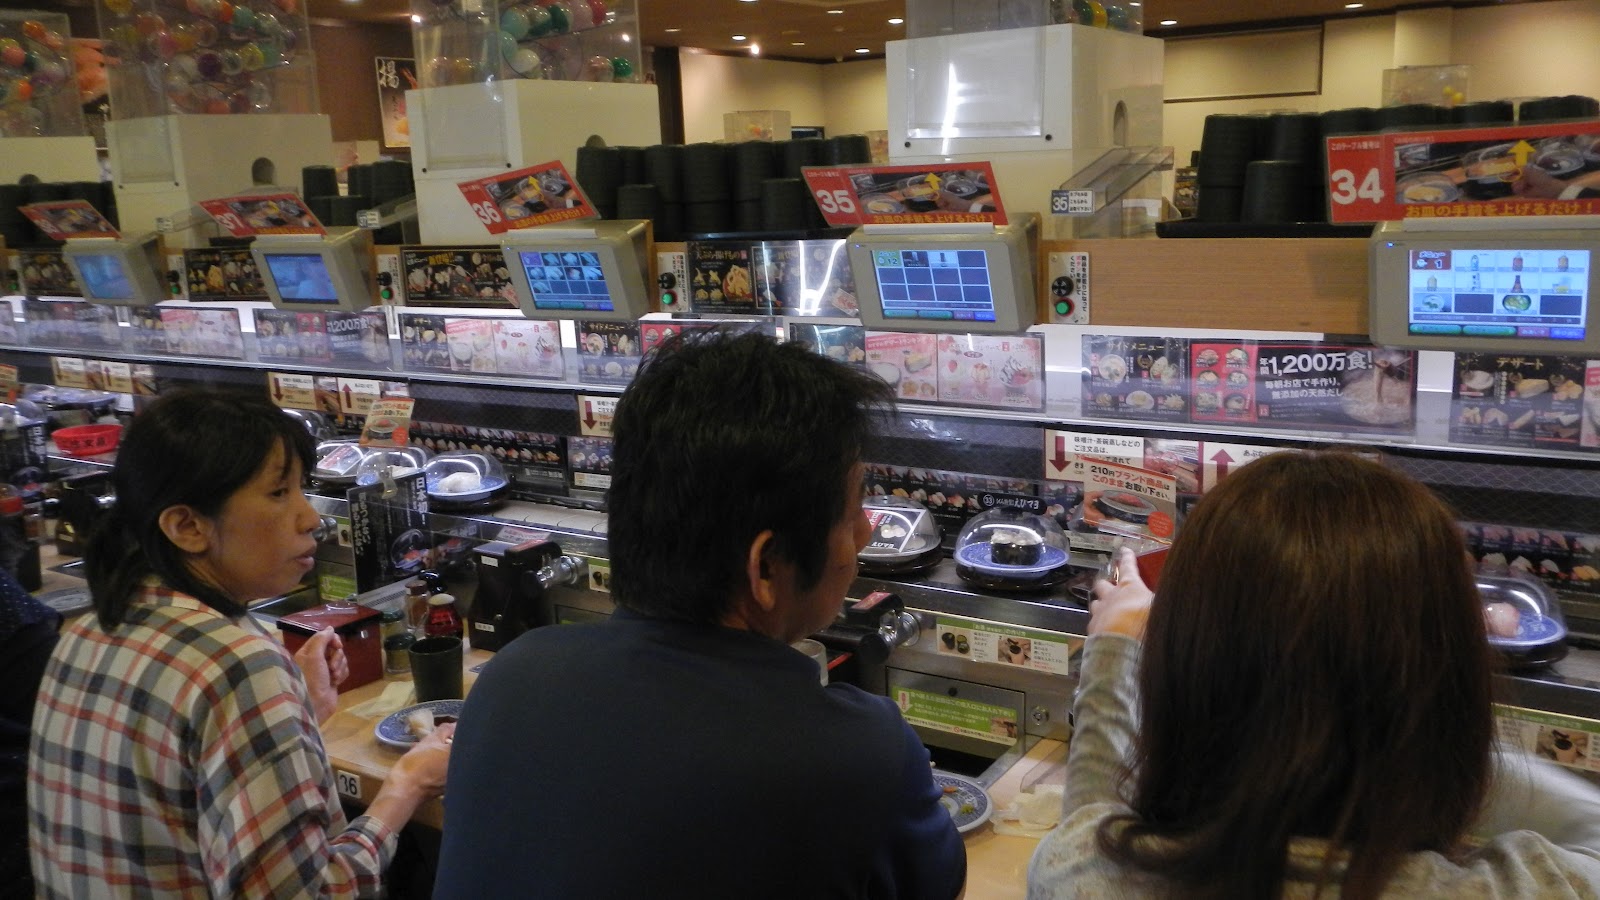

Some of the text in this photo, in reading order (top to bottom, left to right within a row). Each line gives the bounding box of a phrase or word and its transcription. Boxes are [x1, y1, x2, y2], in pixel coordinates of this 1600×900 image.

[1332, 167, 1385, 205] 34
[816, 189, 856, 214] 35
[1052, 196, 1068, 211] 35
[217, 212, 245, 230] 37
[471, 201, 502, 225] 36
[1106, 341, 1165, 351] サイドメニュー
[1496, 357, 1544, 370] デザート
